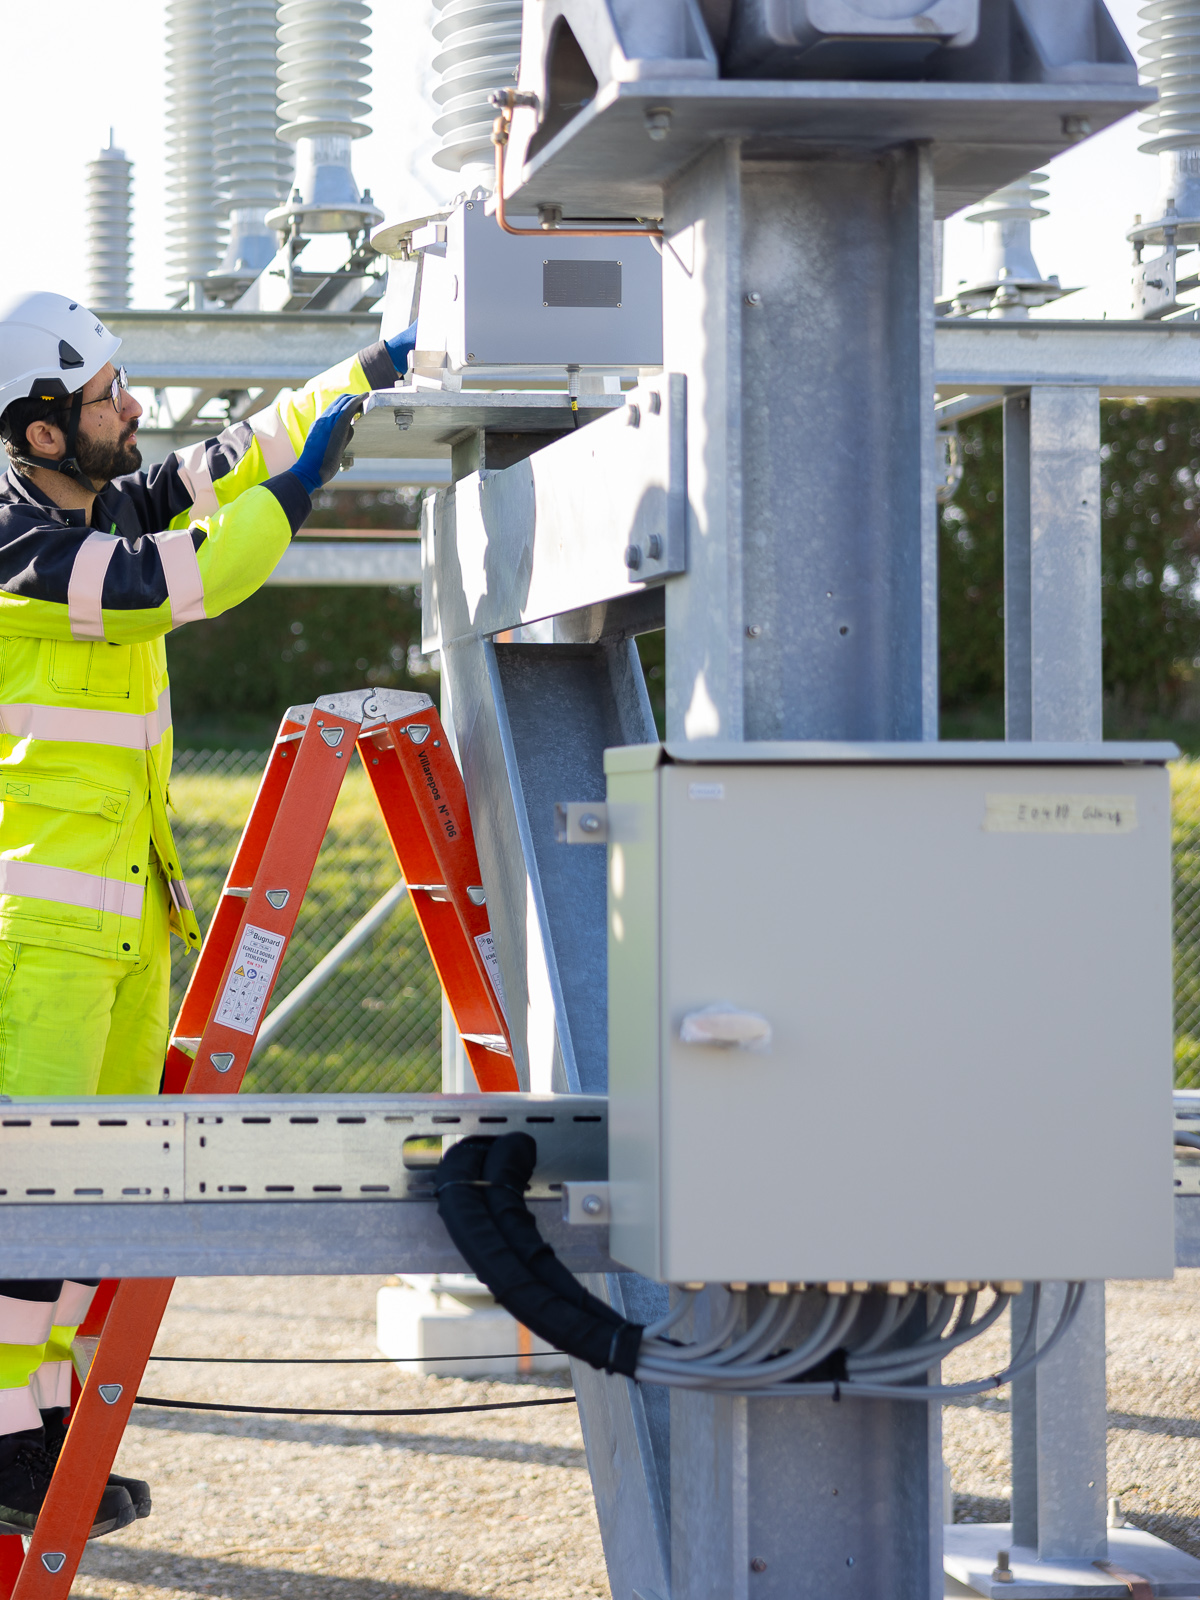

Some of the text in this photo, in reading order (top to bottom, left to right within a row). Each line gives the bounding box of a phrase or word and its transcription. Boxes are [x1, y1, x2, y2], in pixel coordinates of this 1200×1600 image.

[418, 750, 441, 801] Villarepos
[444, 819, 457, 838] 106
[253, 933, 280, 947] Bugnard
[245, 953, 267, 964] STEHLEITER
[259, 951, 275, 960] DOUBLE
